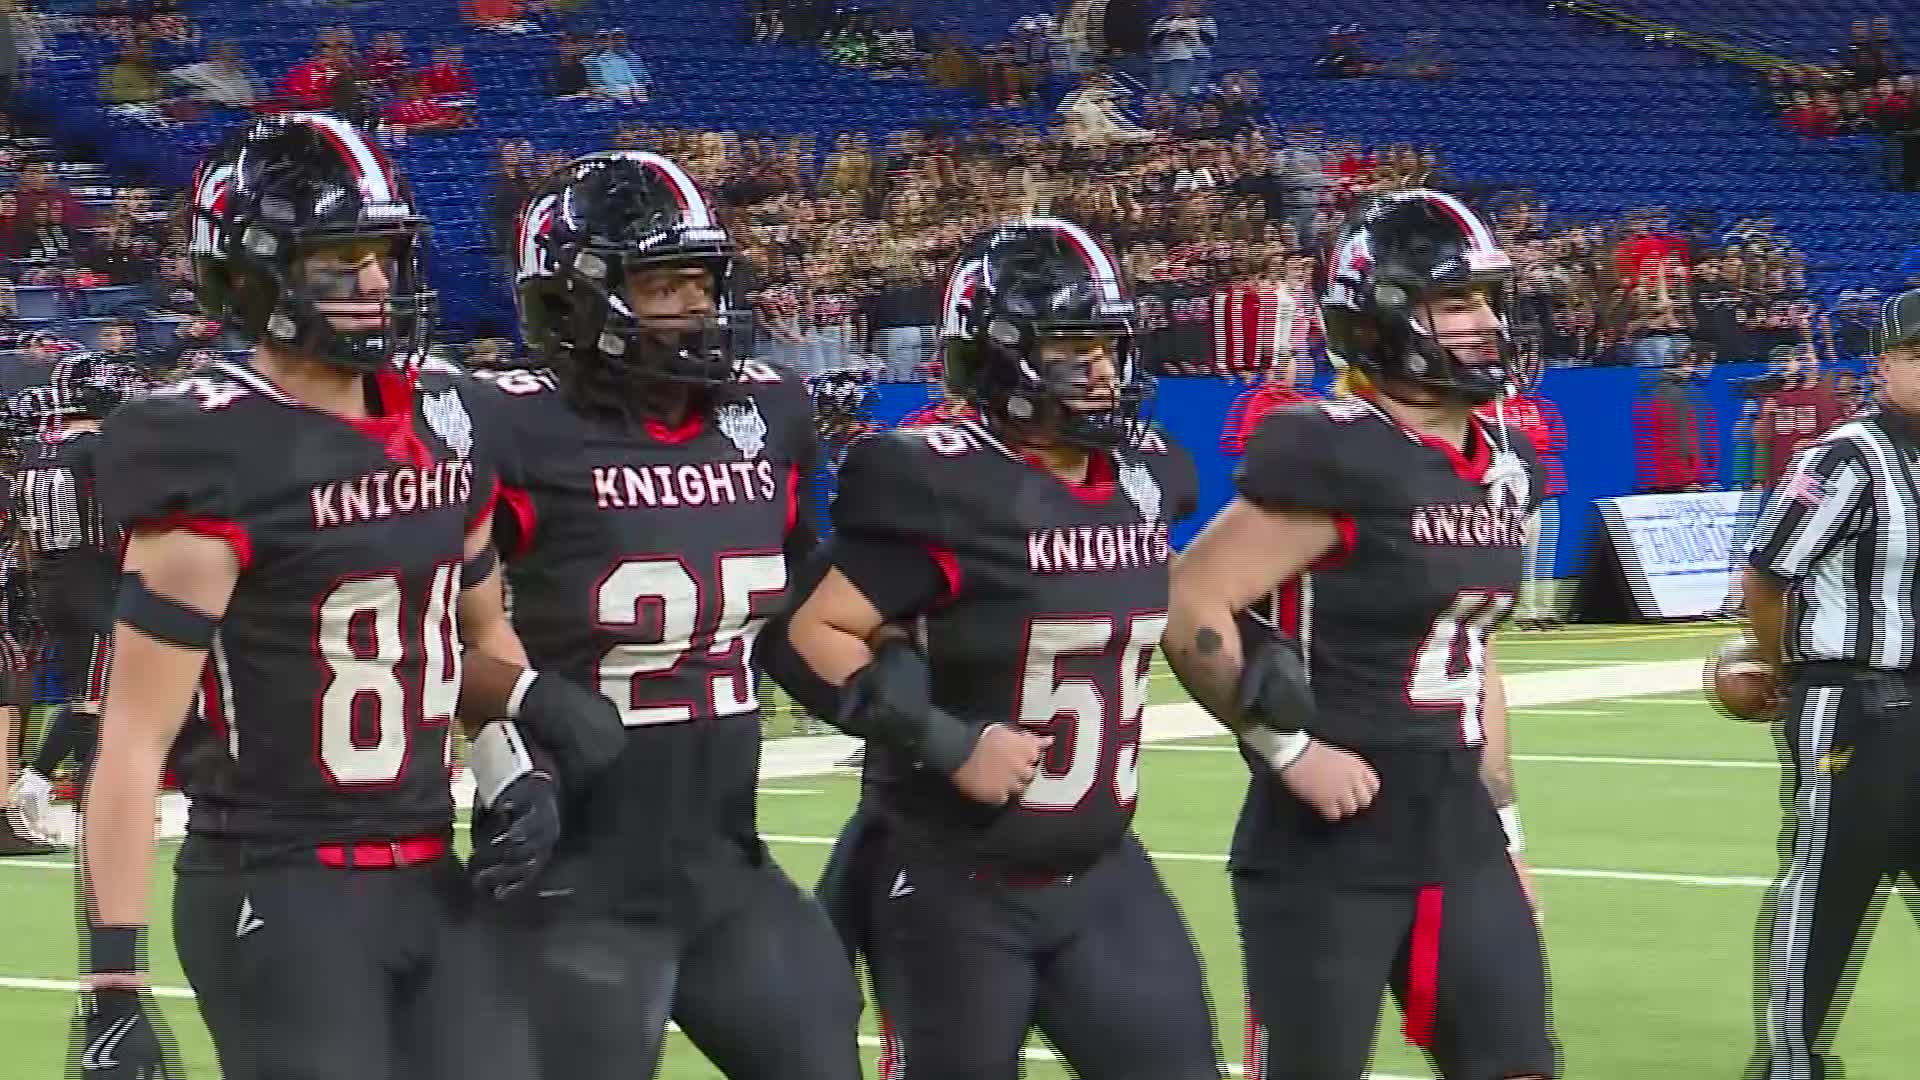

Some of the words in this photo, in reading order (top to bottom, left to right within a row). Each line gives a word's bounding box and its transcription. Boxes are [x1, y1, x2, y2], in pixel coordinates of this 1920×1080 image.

[310, 459, 473, 528] KNIGHTS
[592, 459, 777, 509] KNIGHTS
[1410, 503, 1529, 546] KNIGHTS
[1027, 523, 1169, 574] KNIGHTS
[312, 561, 465, 788] 84
[591, 548, 788, 728] 25
[1404, 586, 1516, 750] 4
[1014, 607, 1168, 812] 55
